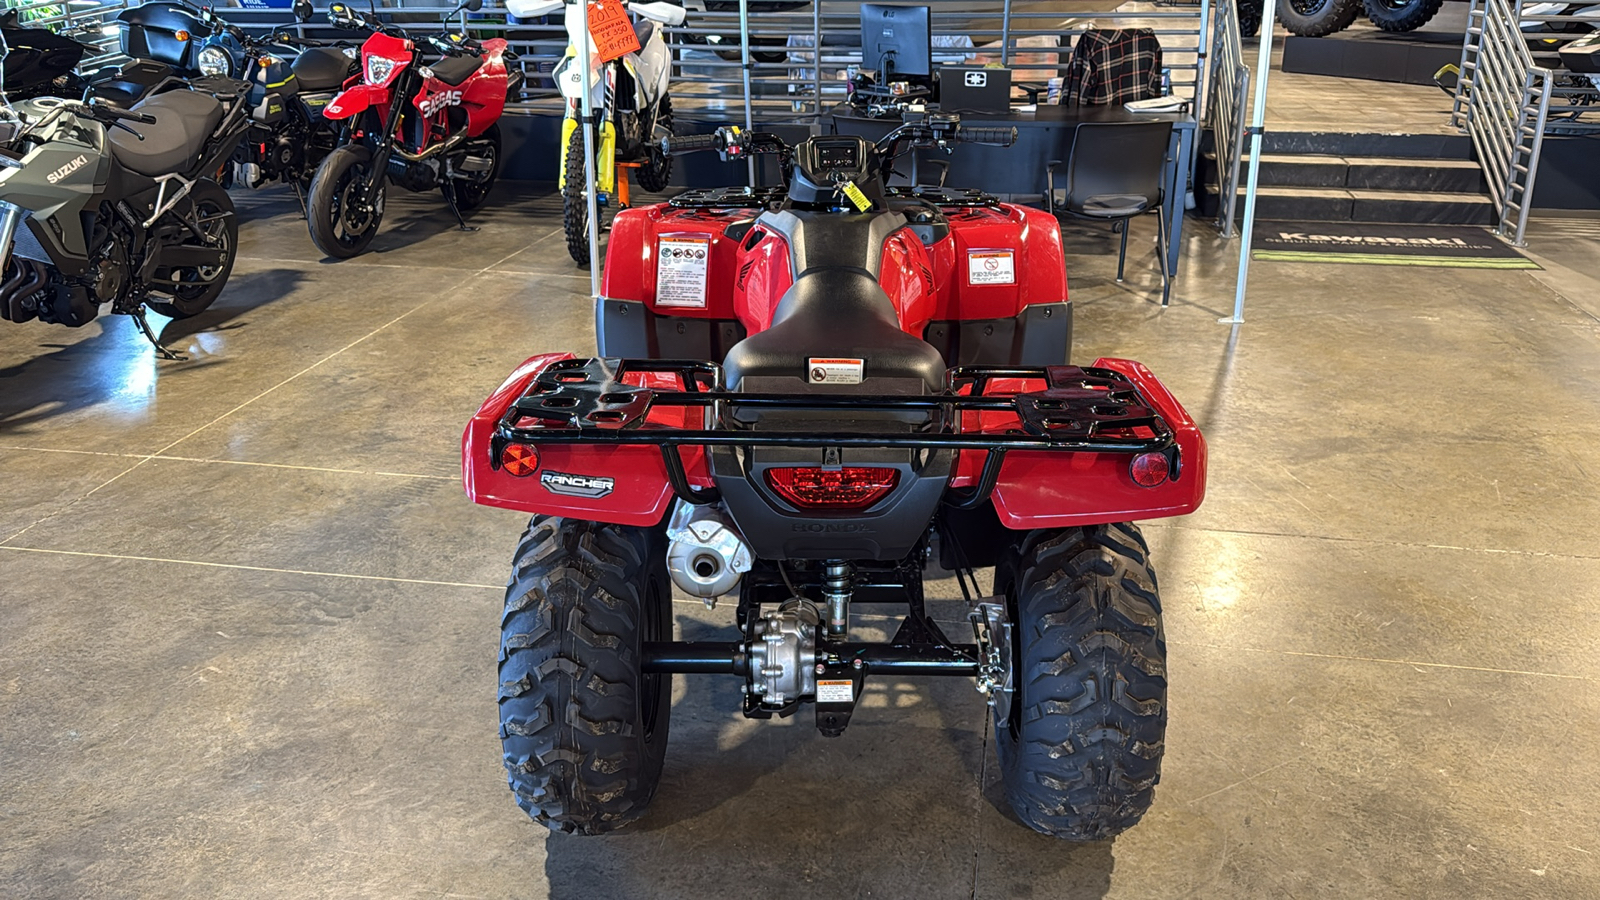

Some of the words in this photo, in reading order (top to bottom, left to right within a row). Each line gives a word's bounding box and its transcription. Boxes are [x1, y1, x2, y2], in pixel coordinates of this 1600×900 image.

[588, 5, 619, 24] 2019
[613, 25, 628, 36] 350
[46, 154, 88, 184] SUZUKI
[1279, 232, 1467, 246] Kawasaki
[541, 474, 614, 490] RANCHER
[792, 523, 877, 533] HONDA
